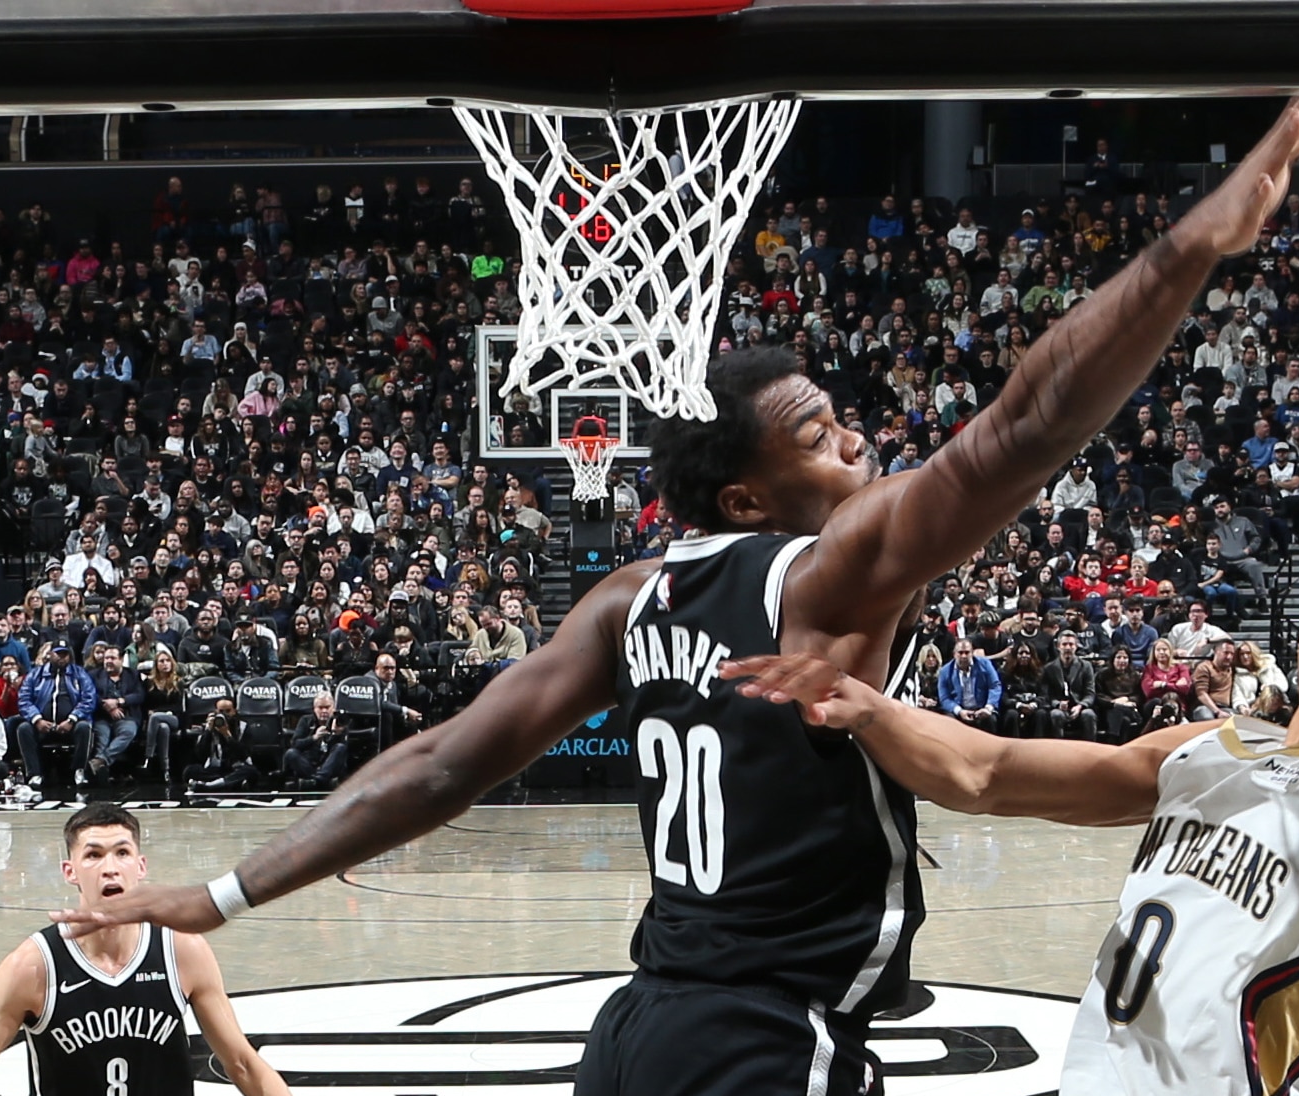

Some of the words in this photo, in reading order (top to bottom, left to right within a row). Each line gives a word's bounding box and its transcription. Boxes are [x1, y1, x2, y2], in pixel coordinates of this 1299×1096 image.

[625, 624, 731, 700] SHARPE
[193, 686, 226, 696] QATAR
[244, 687, 276, 696] QATAR
[341, 685, 373, 695] QATAR
[637, 717, 725, 895] 20
[1104, 899, 1176, 1026] 0
[51, 1006, 179, 1054] BROOKLYN
